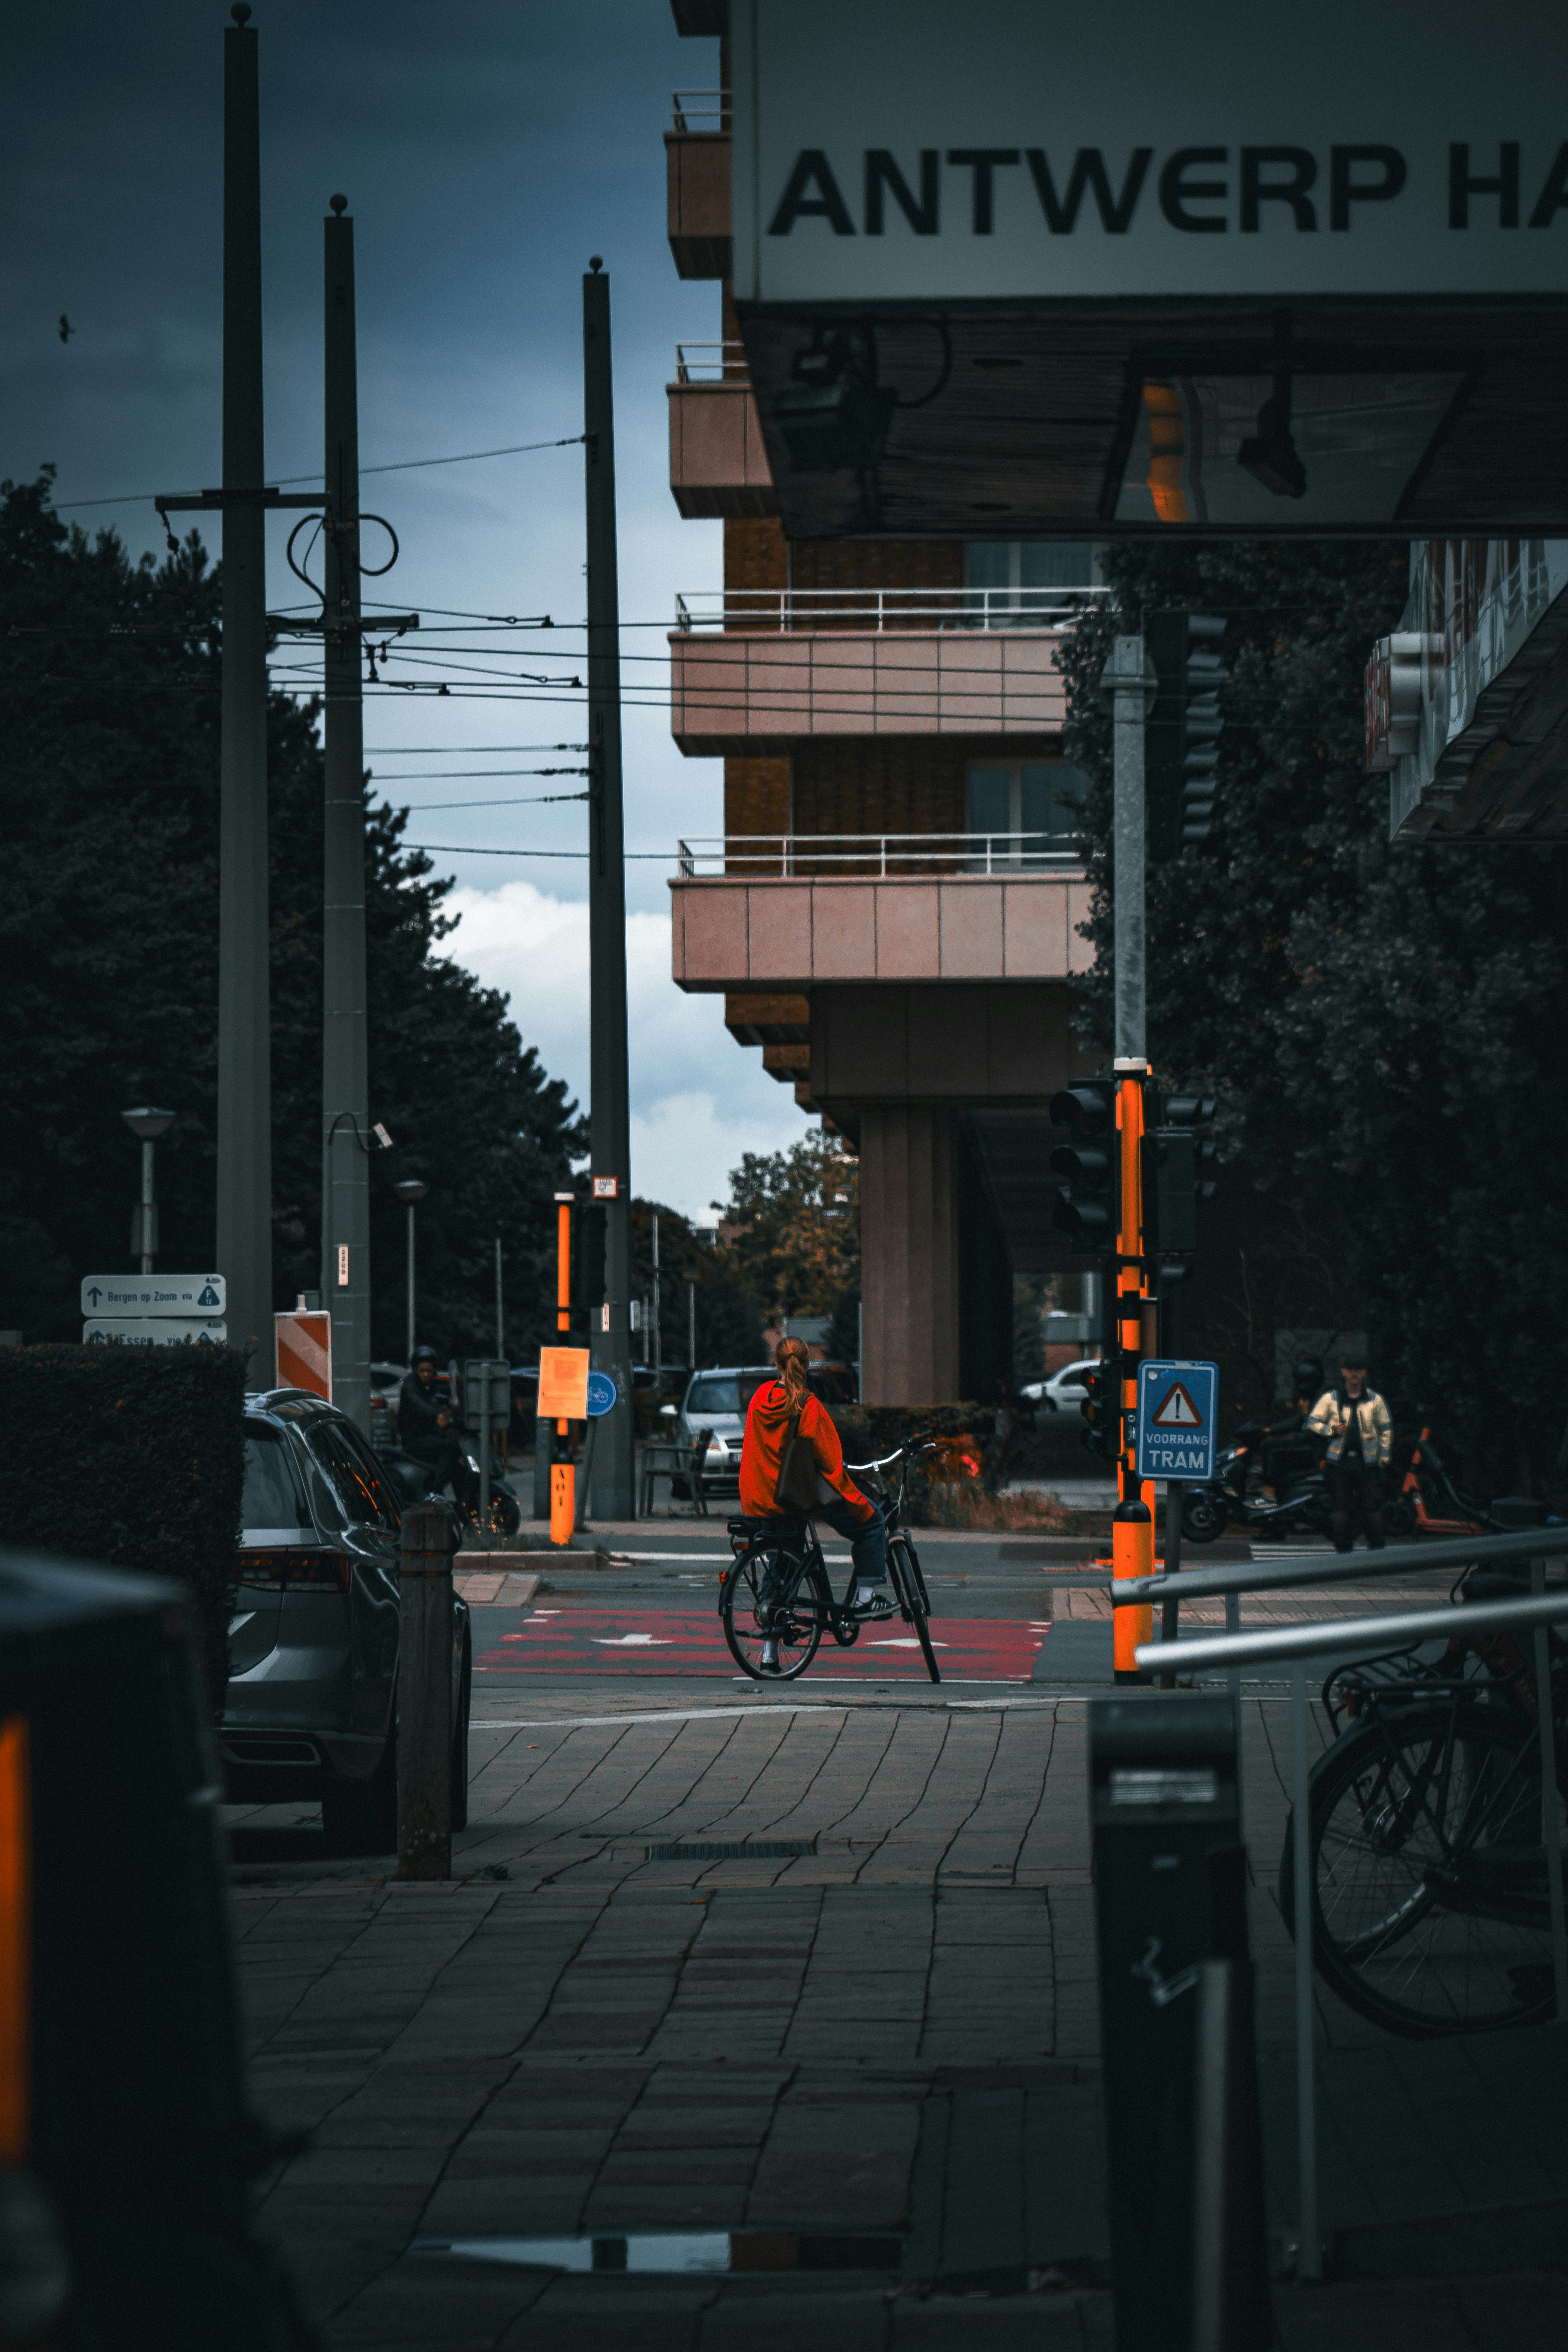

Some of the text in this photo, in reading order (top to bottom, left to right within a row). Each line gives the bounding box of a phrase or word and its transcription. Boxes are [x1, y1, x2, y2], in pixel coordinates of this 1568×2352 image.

[766, 142, 1409, 237] ANTWERP
[108, 1292, 137, 1304] Bergen
[140, 1294, 151, 1303] op
[154, 1291, 177, 1301] Zoom
[1146, 1433, 1209, 1446] VOORRANG
[1149, 1450, 1205, 1469] TRAM
